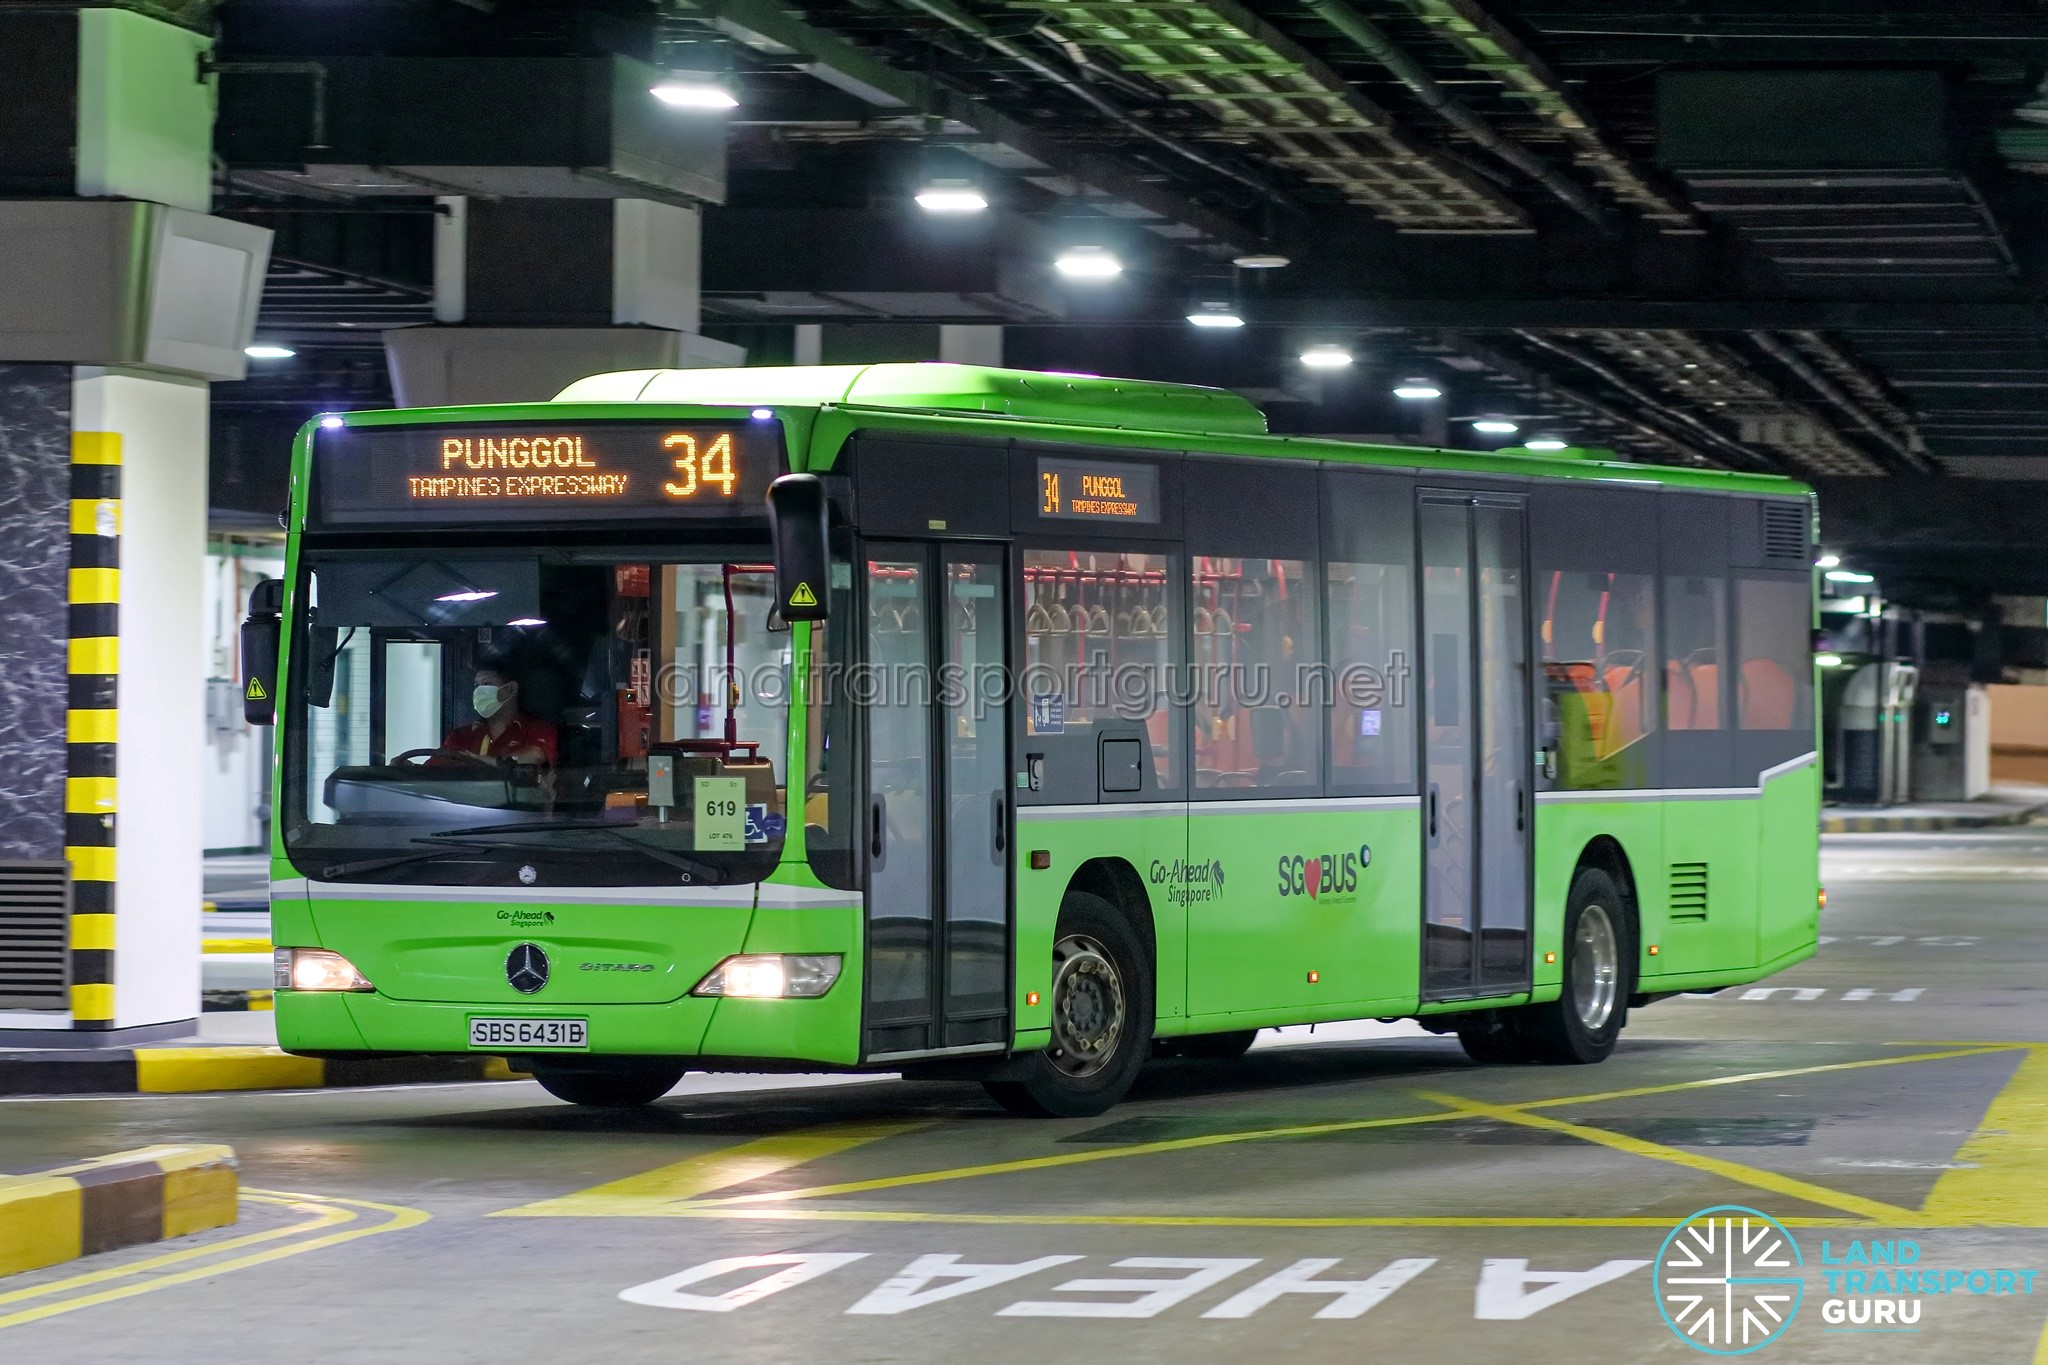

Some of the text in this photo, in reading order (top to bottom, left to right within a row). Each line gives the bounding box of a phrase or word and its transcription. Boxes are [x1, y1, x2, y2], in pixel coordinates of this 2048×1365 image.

[442, 436, 596, 470] PUNGGOL
[663, 433, 736, 497] 34
[408, 474, 628, 498] TAMPINES EXPRESSWAY
[1042, 472, 1060, 513] 34
[1082, 475, 1126, 498] PUNGGOL
[706, 801, 736, 816] 619
[1150, 858, 1210, 884] Go-Ahead
[1168, 884, 1211, 907] Singapore
[496, 910, 543, 920] Go-Ahead
[510, 920, 544, 928] Singapore
[475, 1022, 582, 1043] SBS6431B
